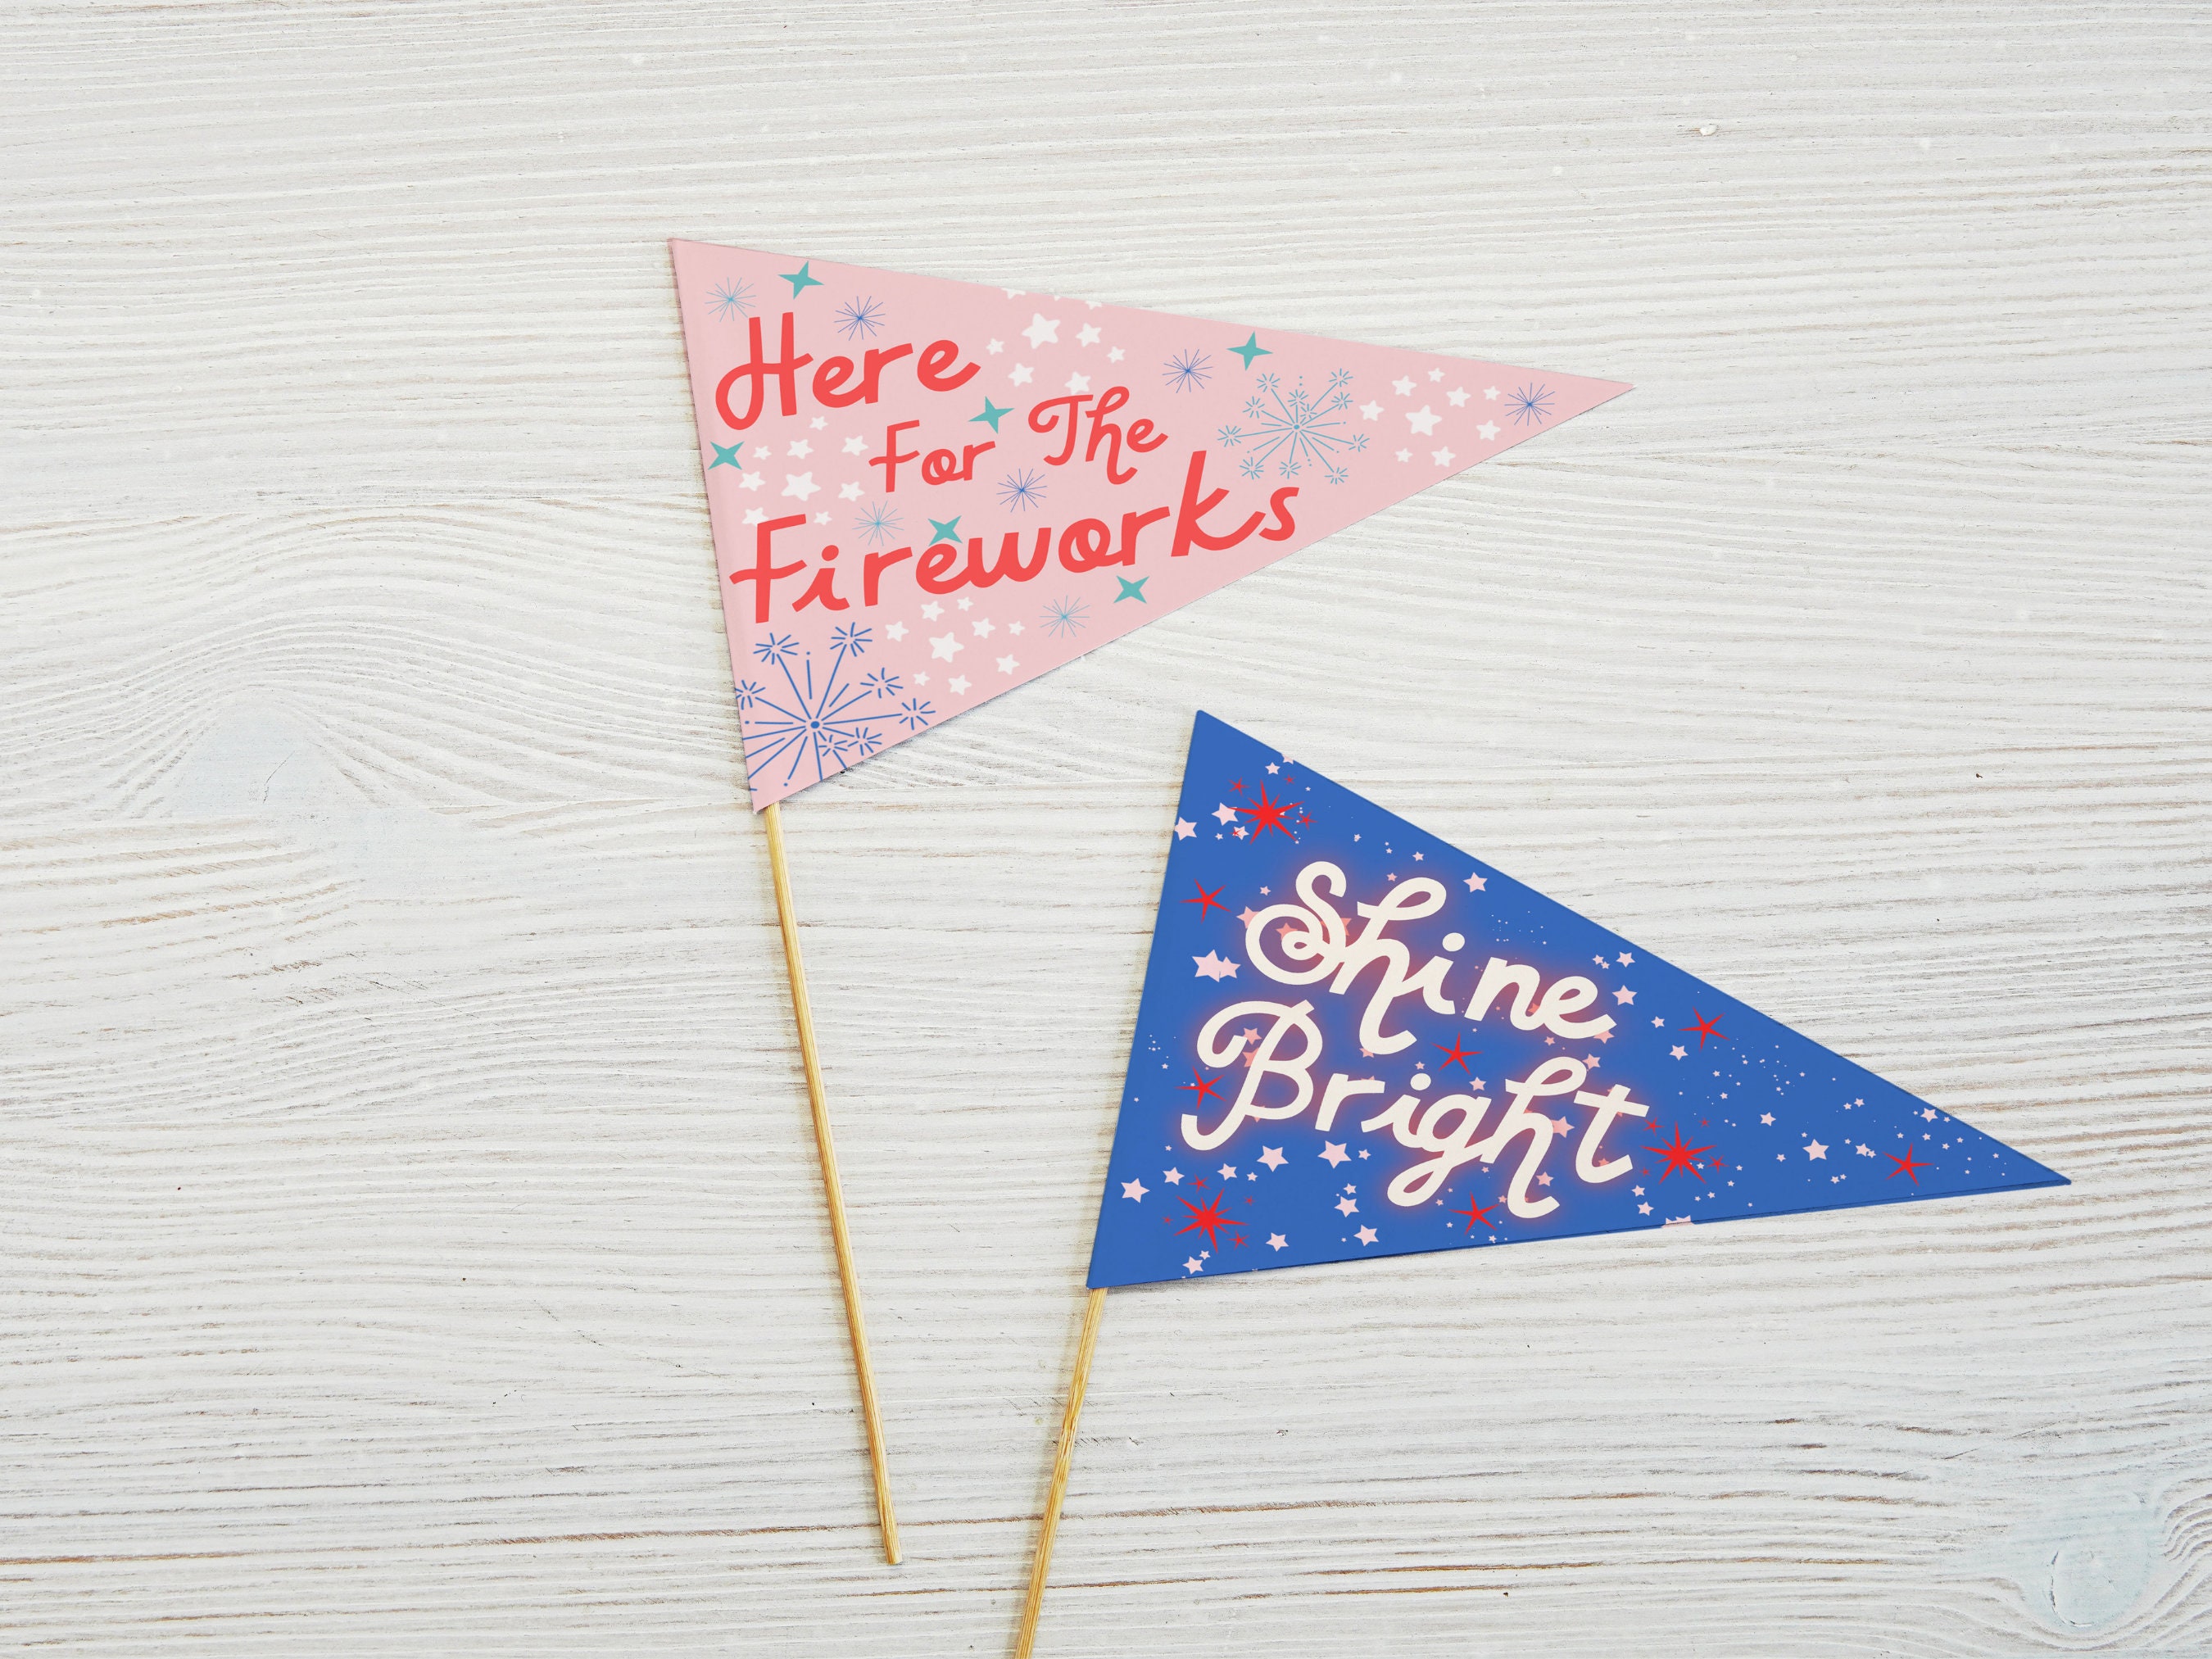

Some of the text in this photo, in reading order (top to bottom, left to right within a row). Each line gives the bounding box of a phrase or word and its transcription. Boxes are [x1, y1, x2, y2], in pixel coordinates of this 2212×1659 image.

[715, 311, 981, 431] Here
[868, 386, 1168, 493] For The
[729, 450, 1299, 624] Fireworks
[1245, 861, 1617, 1054] Shine
[1181, 999, 1650, 1218] Bright
